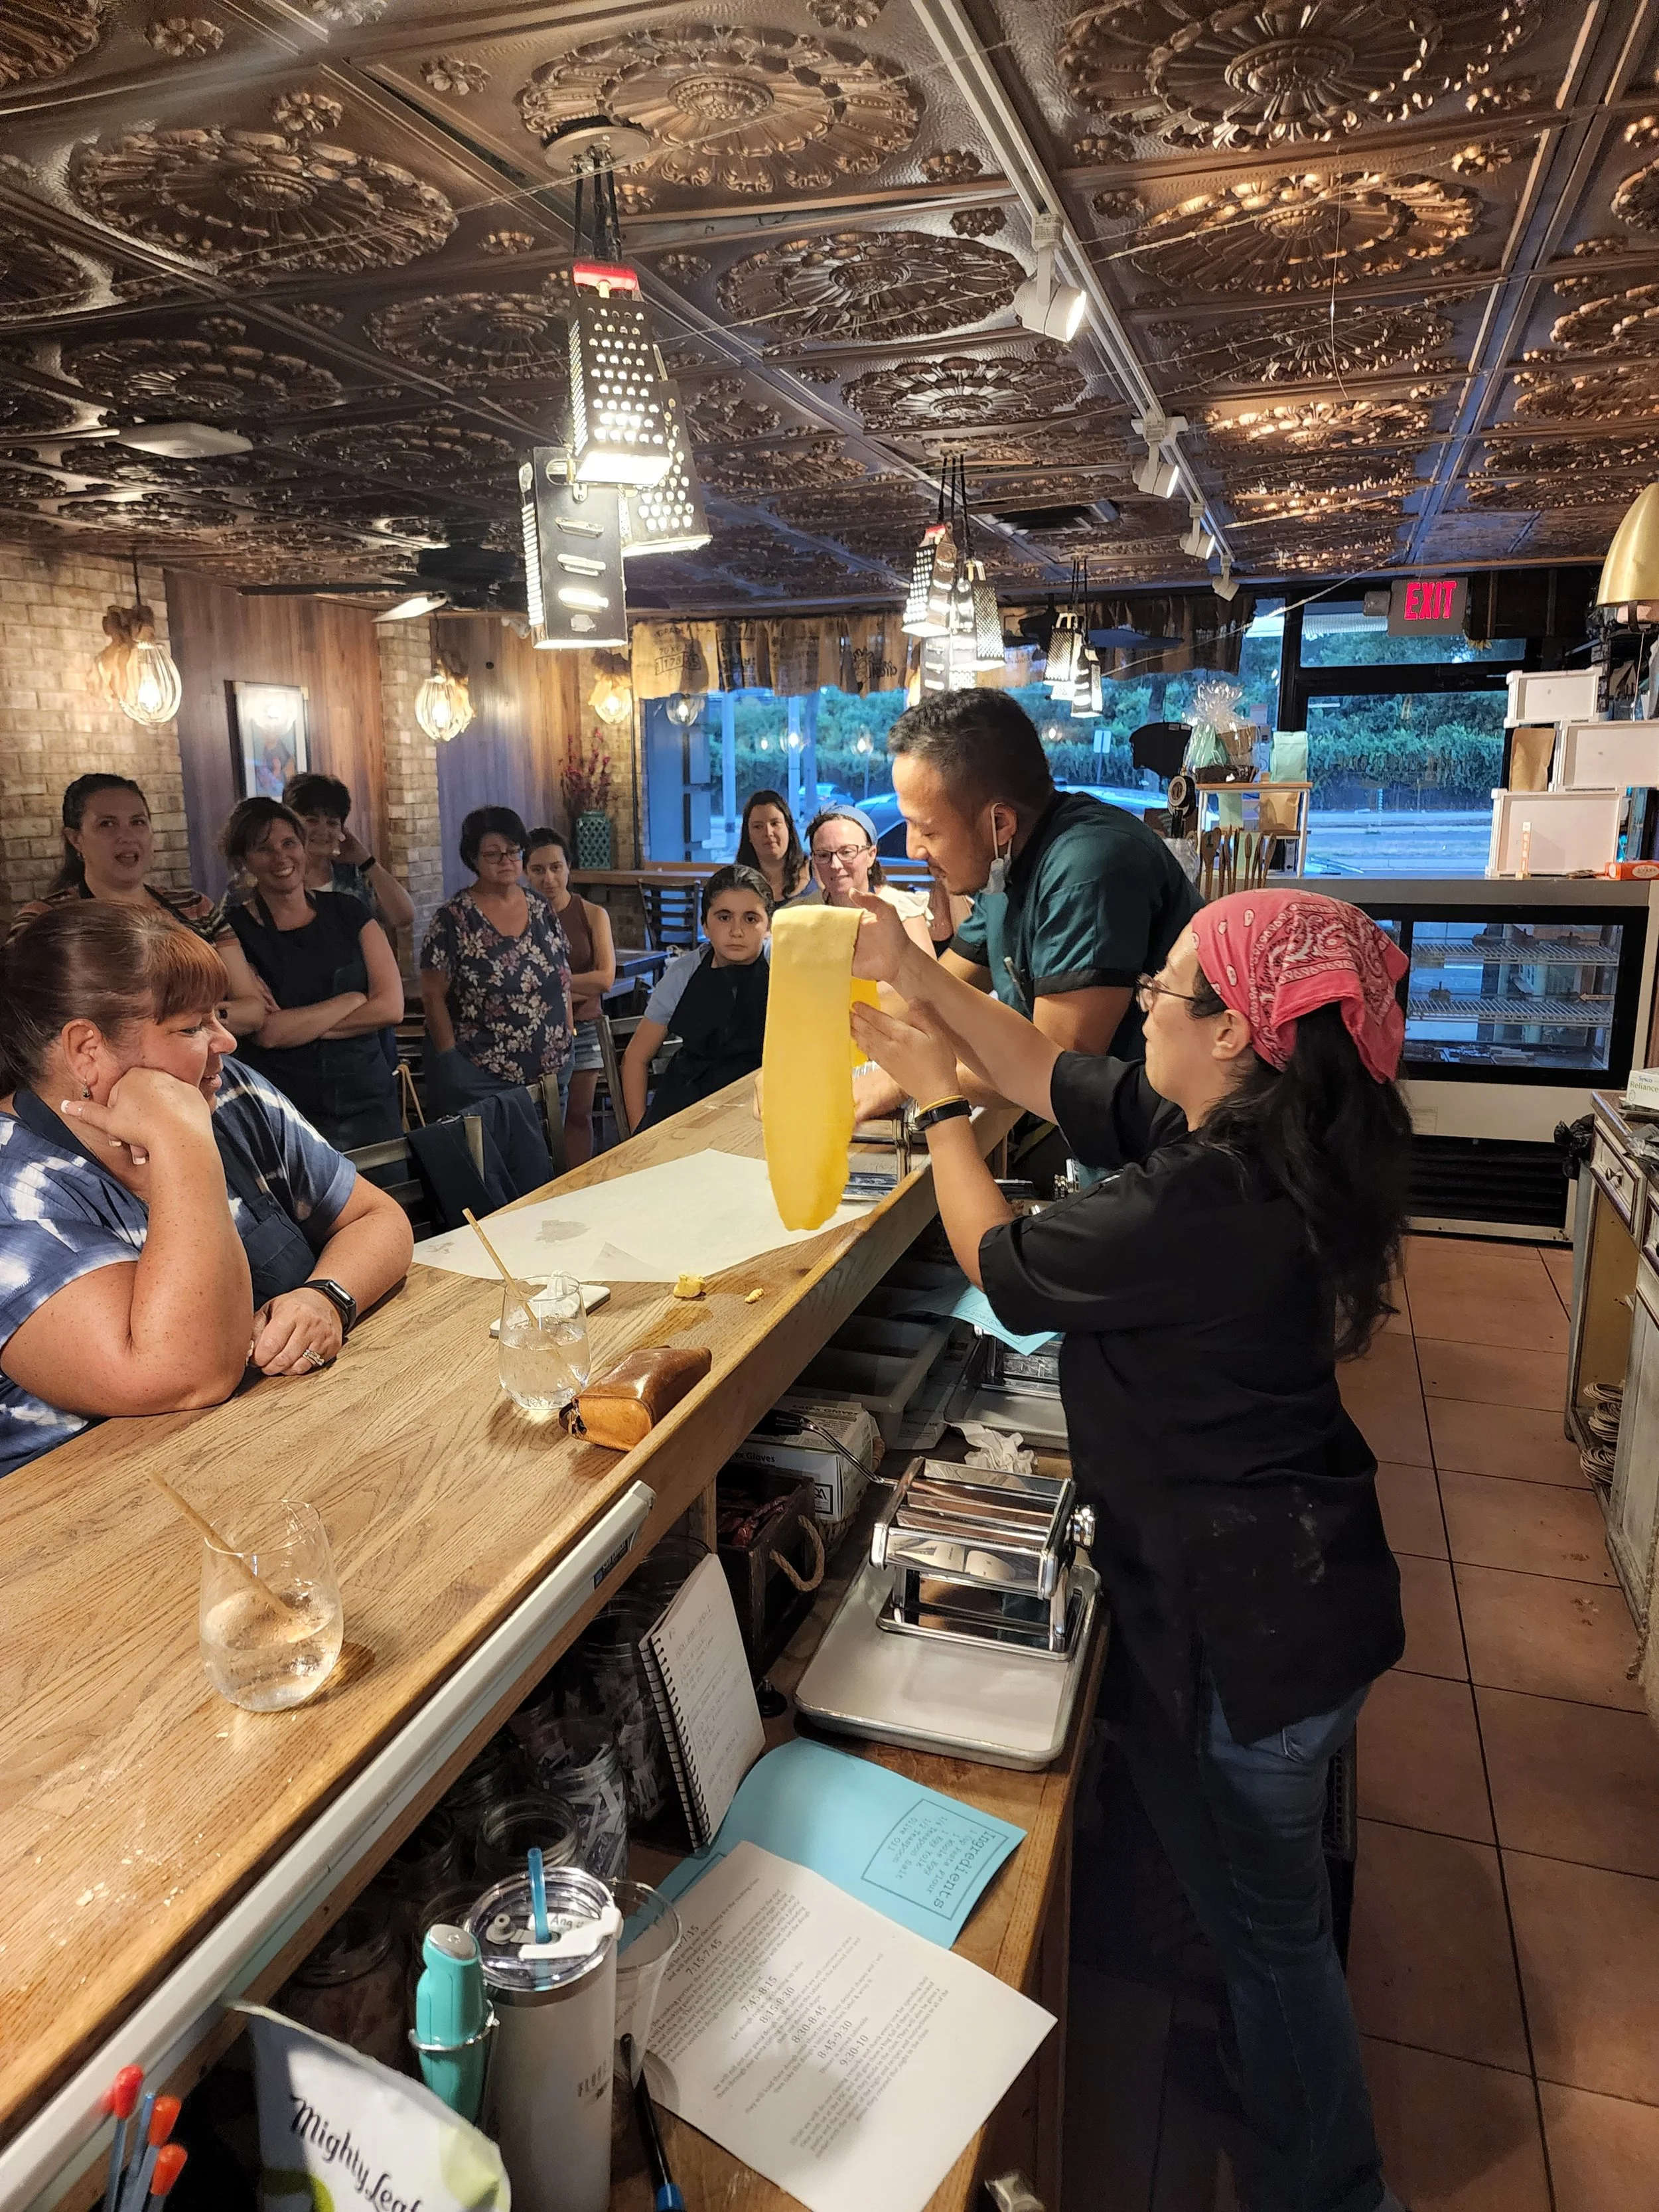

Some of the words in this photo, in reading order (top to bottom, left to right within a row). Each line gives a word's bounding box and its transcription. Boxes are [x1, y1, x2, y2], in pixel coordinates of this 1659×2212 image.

[1404, 580, 1457, 621] EXIT
[1630, 1081, 1659, 1092] Reliance
[746, 1452, 775, 1462] Gloves
[925, 1870, 945, 1894] Flour
[932, 1829, 995, 1909] Ingredients
[685, 1937, 722, 1976] 7:15-7:45
[741, 1974, 778, 2014] 7:45-8:15
[758, 1985, 796, 2024] 8:15-8:30
[790, 2004, 828, 2044] 8:30-8:45
[816, 2019, 853, 2059] 8:45-9:30
[839, 2033, 869, 2067] 9:30-10
[289, 2094, 370, 2194] Mighty
